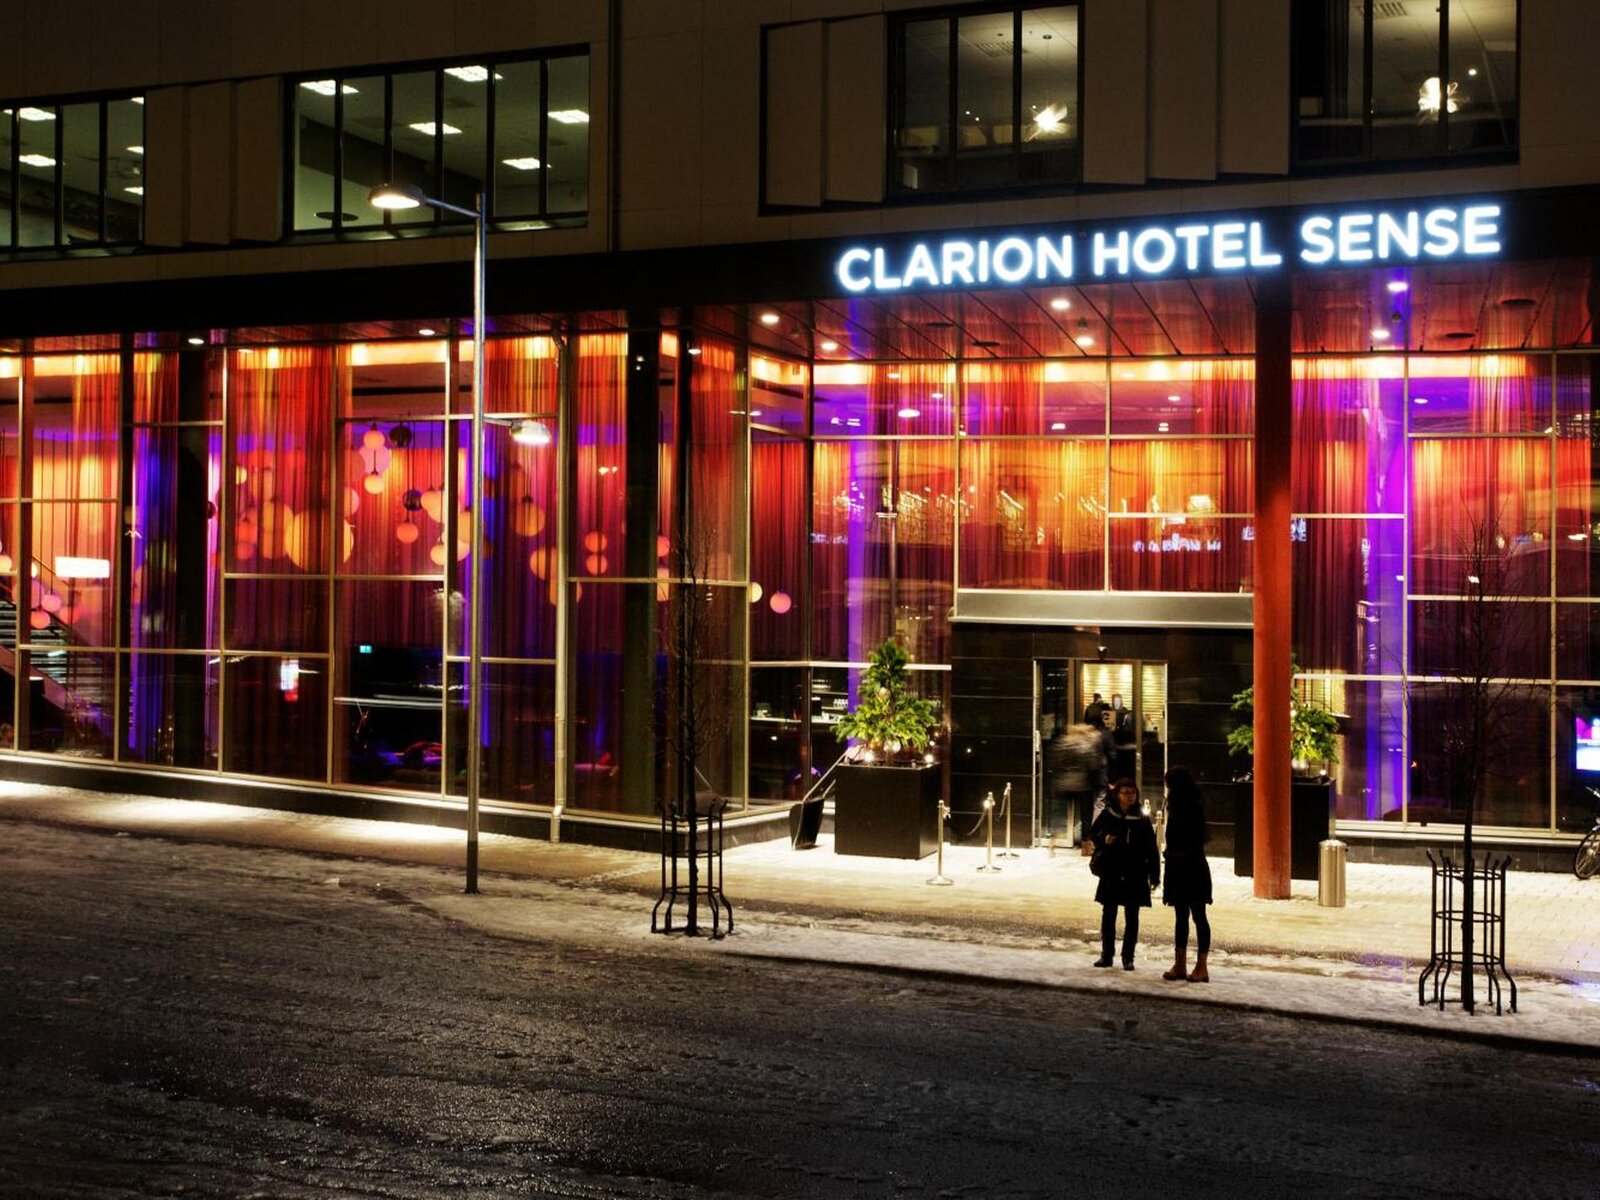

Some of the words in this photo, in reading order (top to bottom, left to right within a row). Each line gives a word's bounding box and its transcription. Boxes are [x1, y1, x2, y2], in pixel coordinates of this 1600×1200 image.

[836, 233, 1074, 293] CLARION
[1092, 220, 1283, 277] HOTEL
[1299, 204, 1502, 265] SENSE
